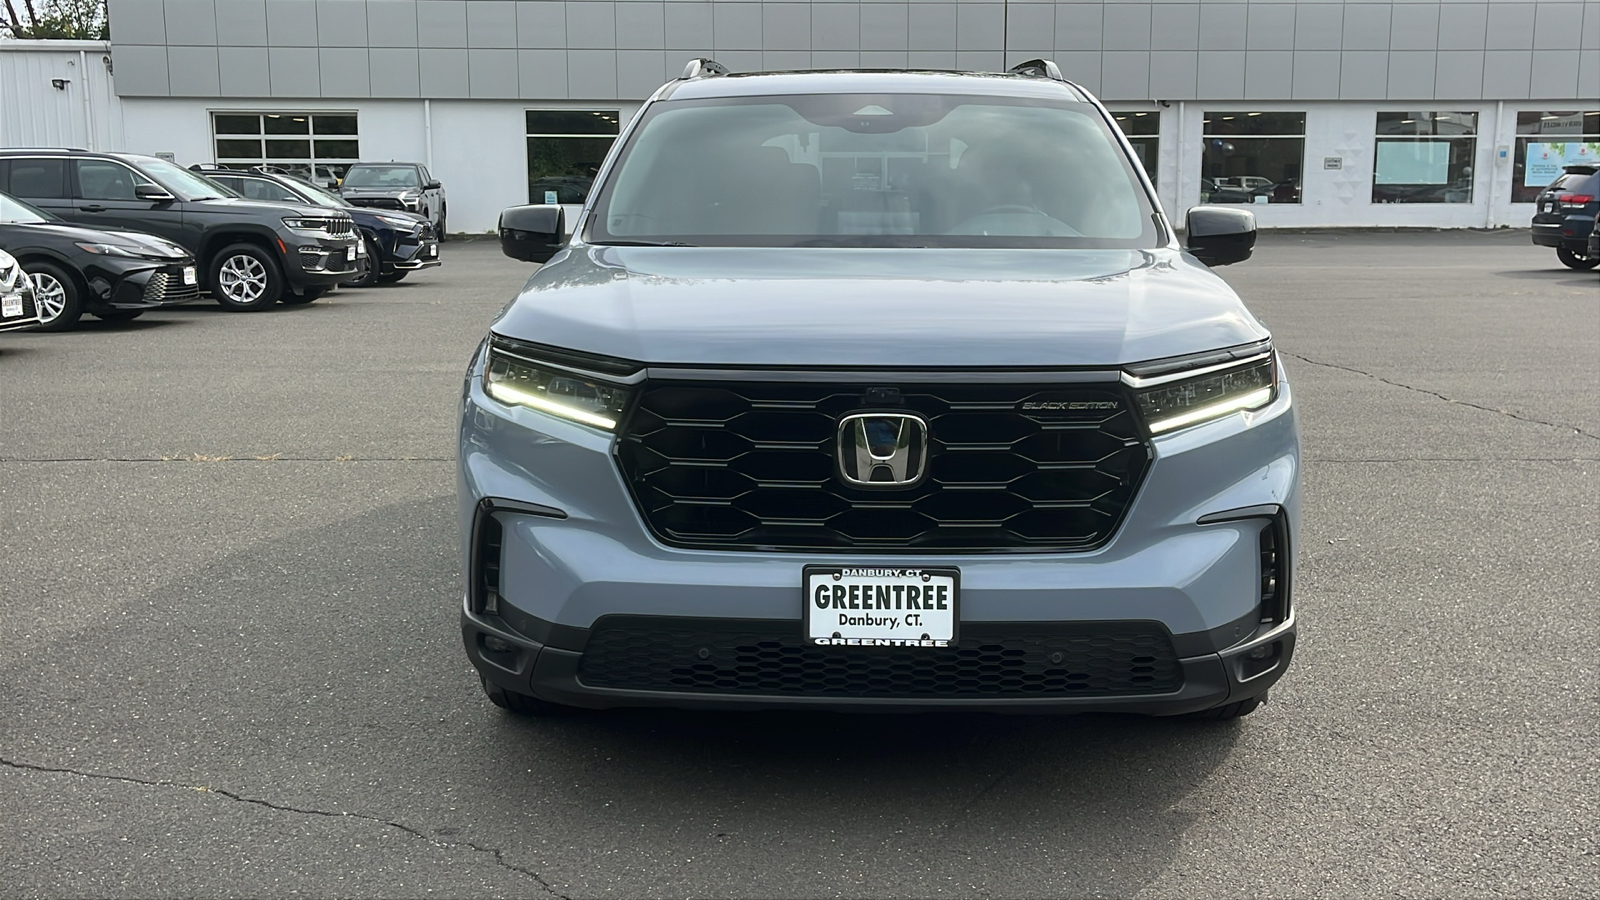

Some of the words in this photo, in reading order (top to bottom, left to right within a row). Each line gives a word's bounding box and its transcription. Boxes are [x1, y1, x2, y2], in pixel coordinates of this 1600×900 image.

[1022, 402, 1067, 410] BLACK
[1068, 401, 1118, 410] EDITION
[841, 568, 902, 578] DANBURY,
[905, 569, 922, 578] CT
[814, 584, 948, 610] GREENTREE
[838, 612, 901, 630] Danbury,
[904, 613, 923, 627] CT.
[814, 637, 949, 648] GREENTREE
